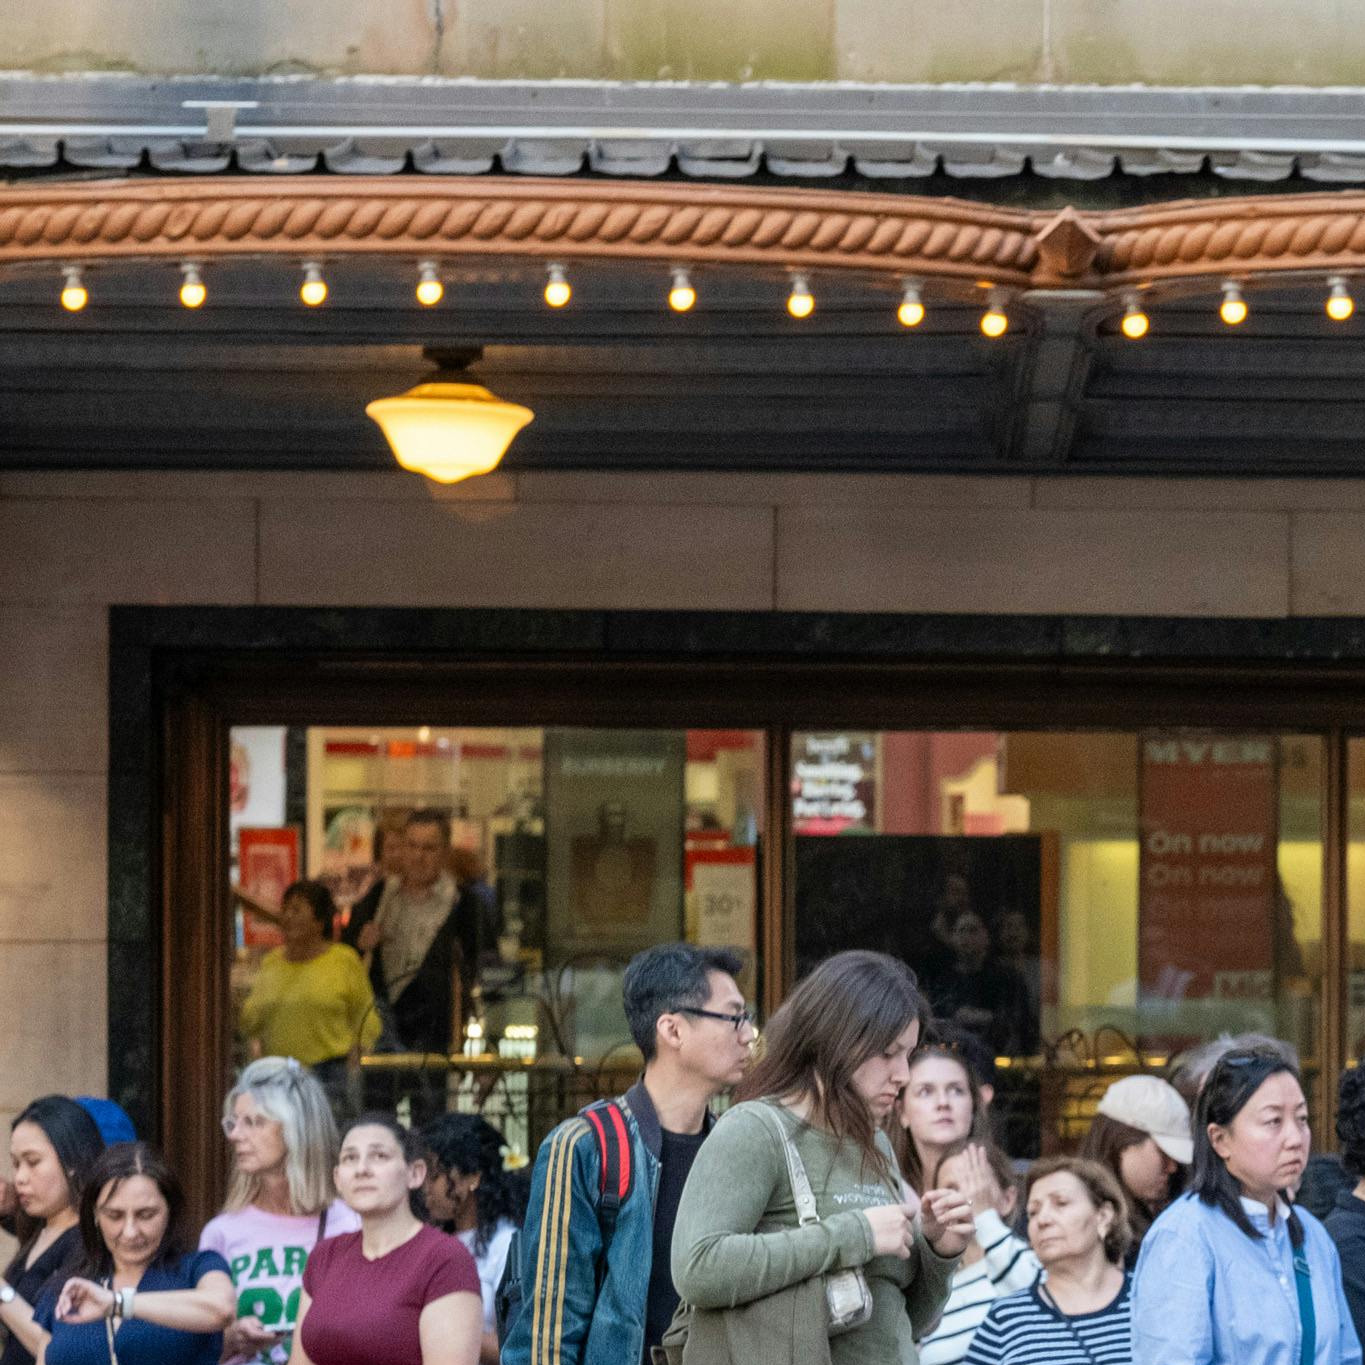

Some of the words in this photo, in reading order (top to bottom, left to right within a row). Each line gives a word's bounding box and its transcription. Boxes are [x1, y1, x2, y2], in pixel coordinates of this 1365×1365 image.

[1148, 830, 1193, 855] On
[1198, 833, 1265, 854] now
[1147, 864, 1193, 886] On
[1198, 866, 1265, 886] now
